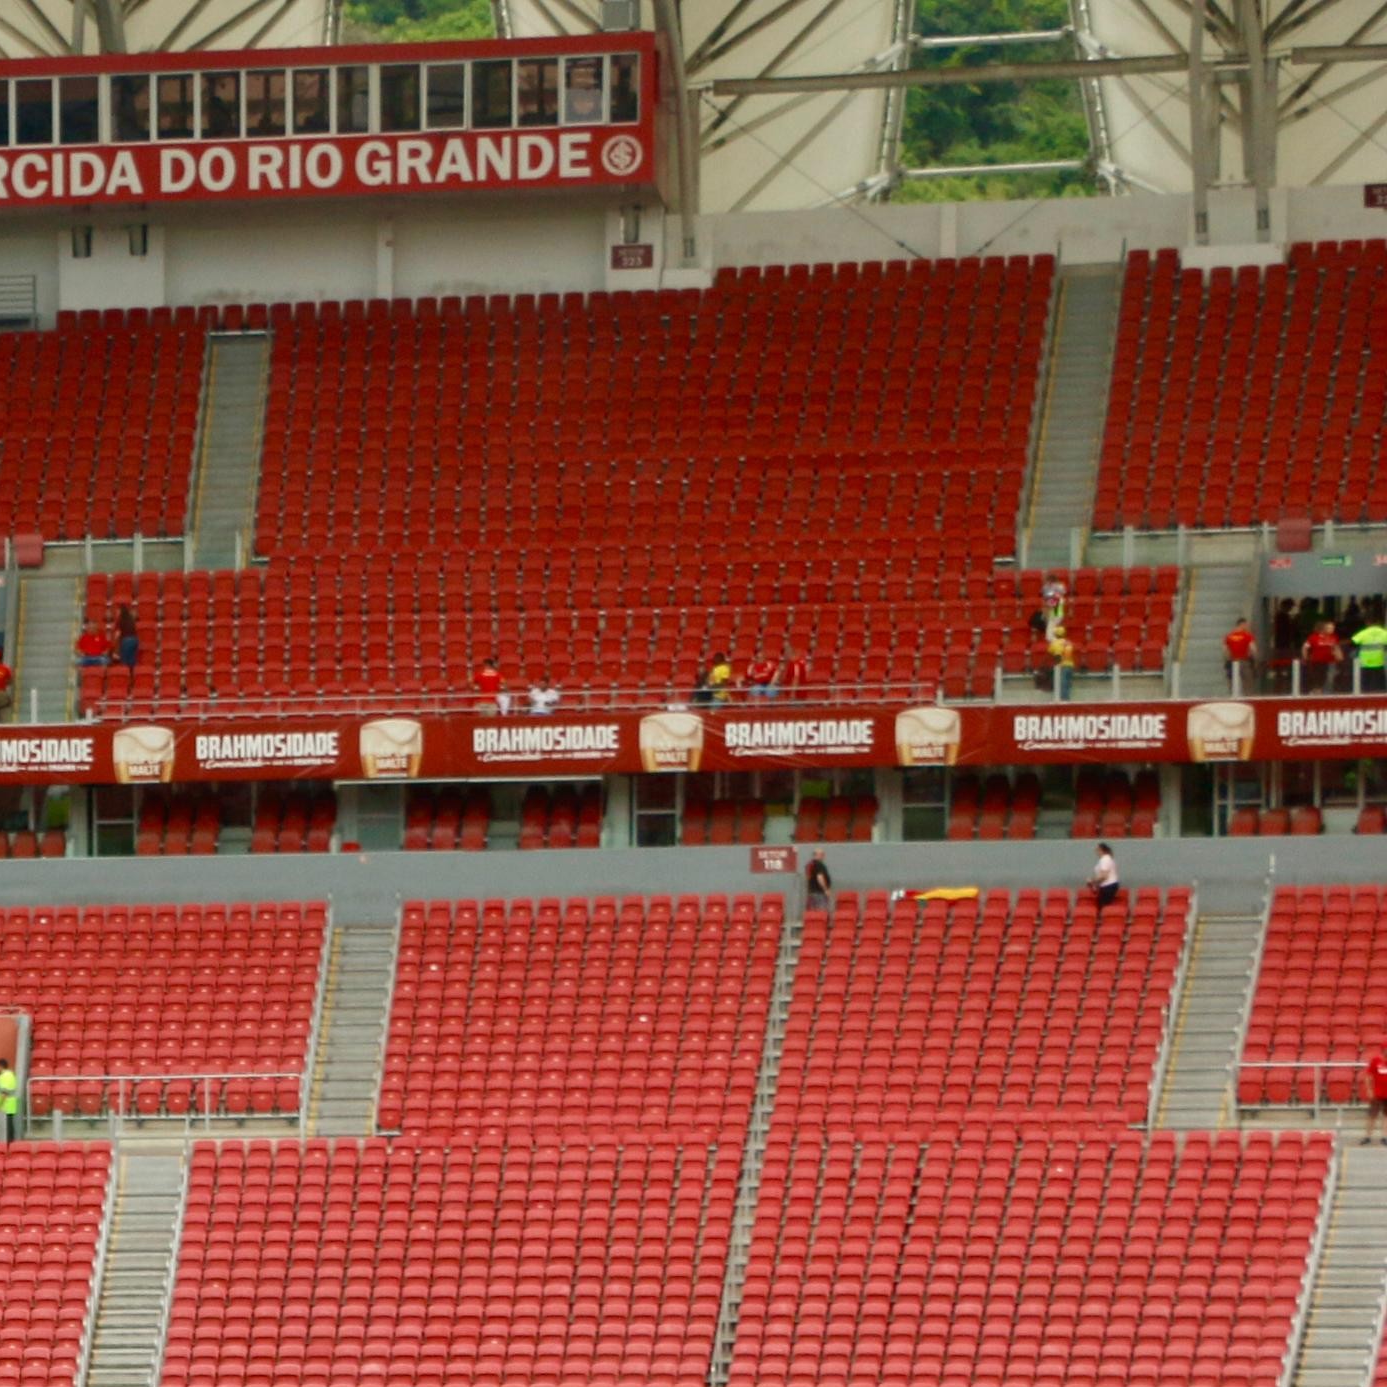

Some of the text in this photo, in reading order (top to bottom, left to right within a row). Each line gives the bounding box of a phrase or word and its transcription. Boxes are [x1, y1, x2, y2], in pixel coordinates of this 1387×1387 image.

[160, 146, 236, 193] DO
[248, 141, 343, 190] RIO
[355, 133, 593, 187] GRANDE
[472, 725, 619, 753] BRAHMOSIDADE
[725, 719, 874, 747] BRAHMOSIDADE
[1014, 713, 1168, 741] BRAHMOSIDADE
[195, 732, 339, 759] BRAHMOSIDADE
[758, 850, 788, 859] SETOR
